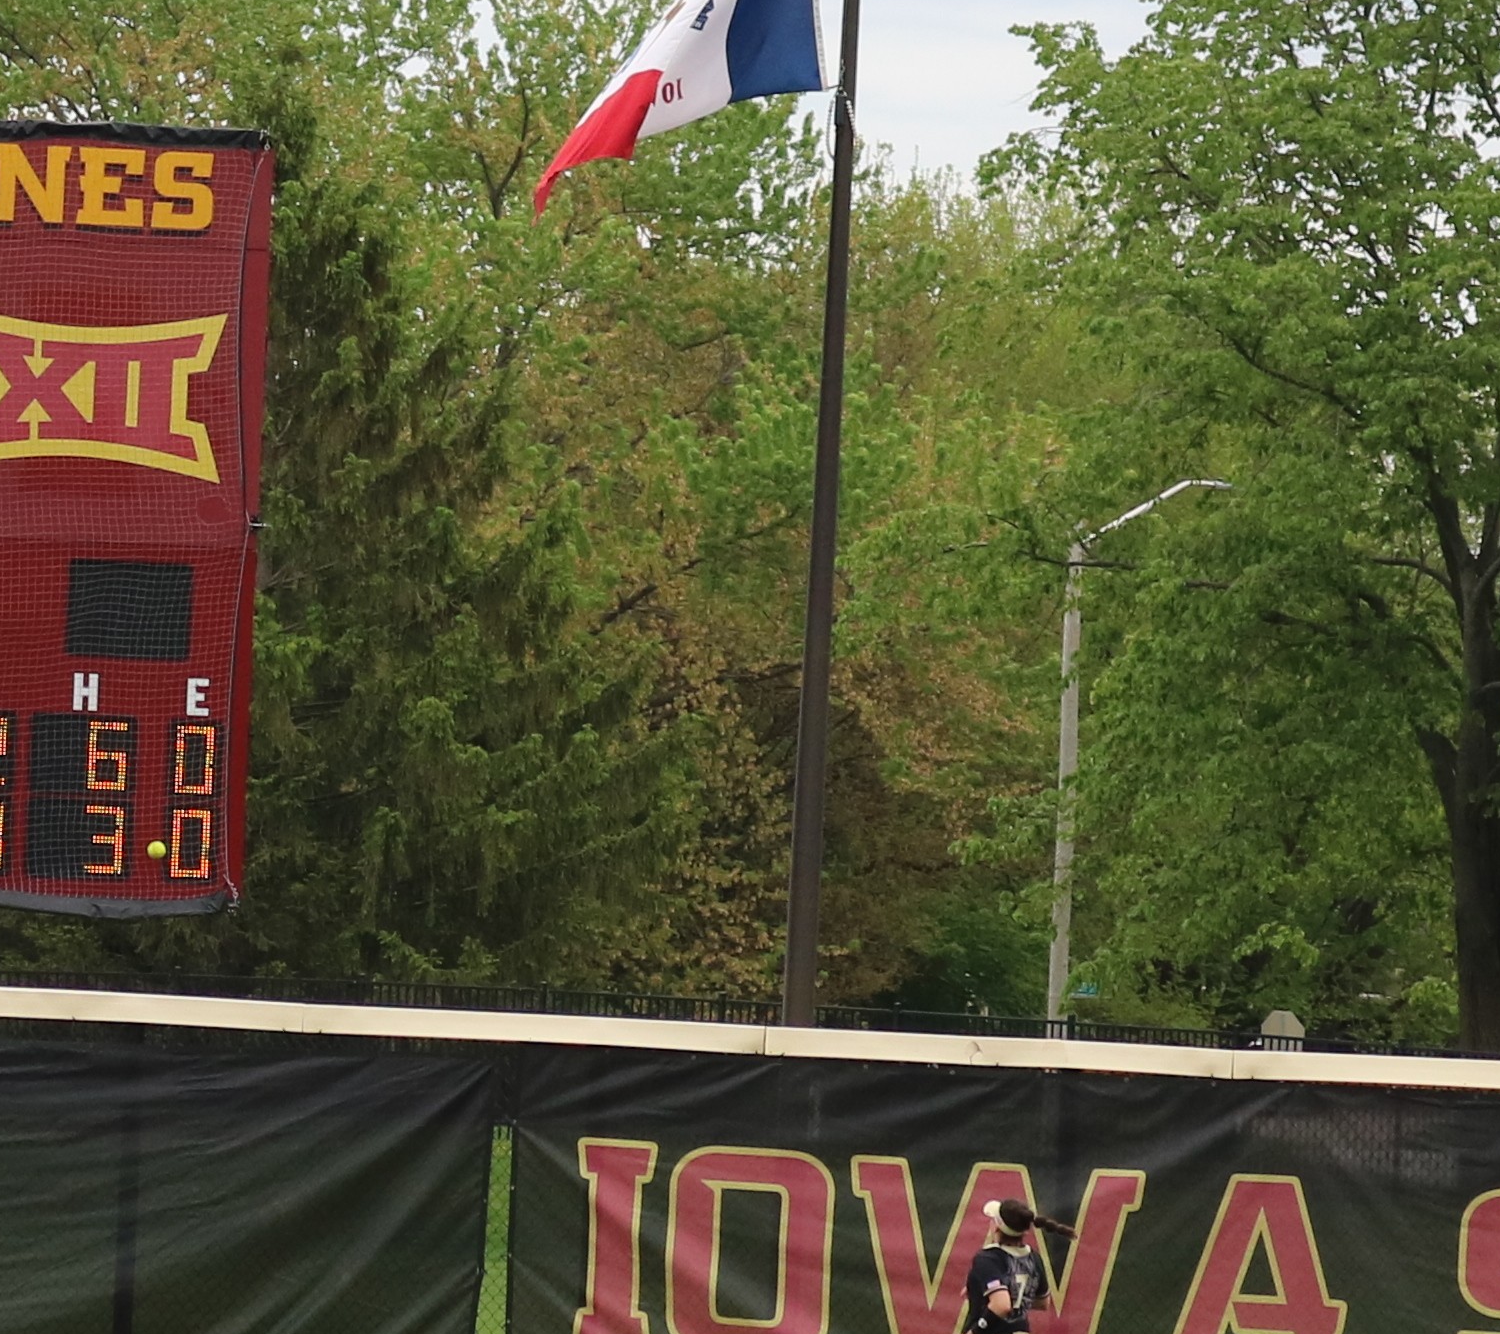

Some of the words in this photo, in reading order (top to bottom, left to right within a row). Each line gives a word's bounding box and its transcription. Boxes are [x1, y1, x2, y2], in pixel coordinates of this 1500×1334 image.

[73, 672, 99, 712] H
[185, 677, 211, 717] E
[86, 721, 128, 792] 6
[174, 725, 215, 796] 0
[83, 804, 125, 875] 3
[169, 808, 212, 879] 0
[1012, 1273, 1029, 1309] 7
